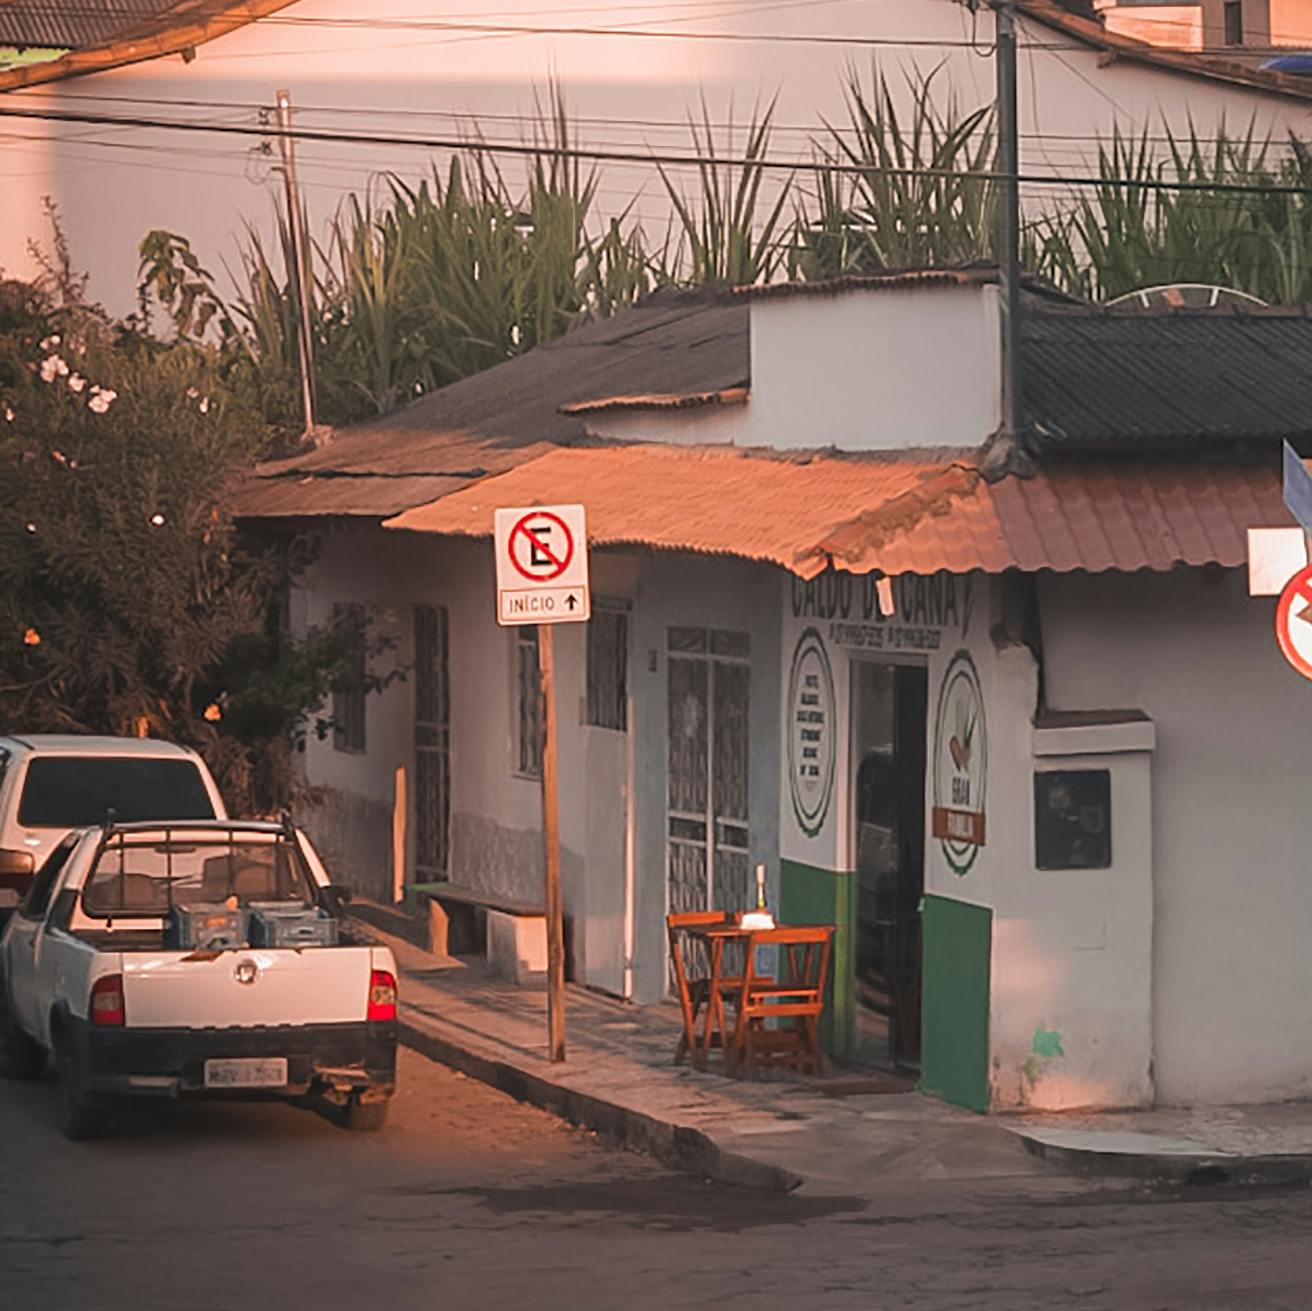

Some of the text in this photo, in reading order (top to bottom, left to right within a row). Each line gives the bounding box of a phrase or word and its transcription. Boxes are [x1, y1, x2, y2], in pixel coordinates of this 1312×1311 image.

[530, 526, 552, 566] E
[509, 596, 555, 614] INÍCIO
[901, 574, 959, 626] CANA
